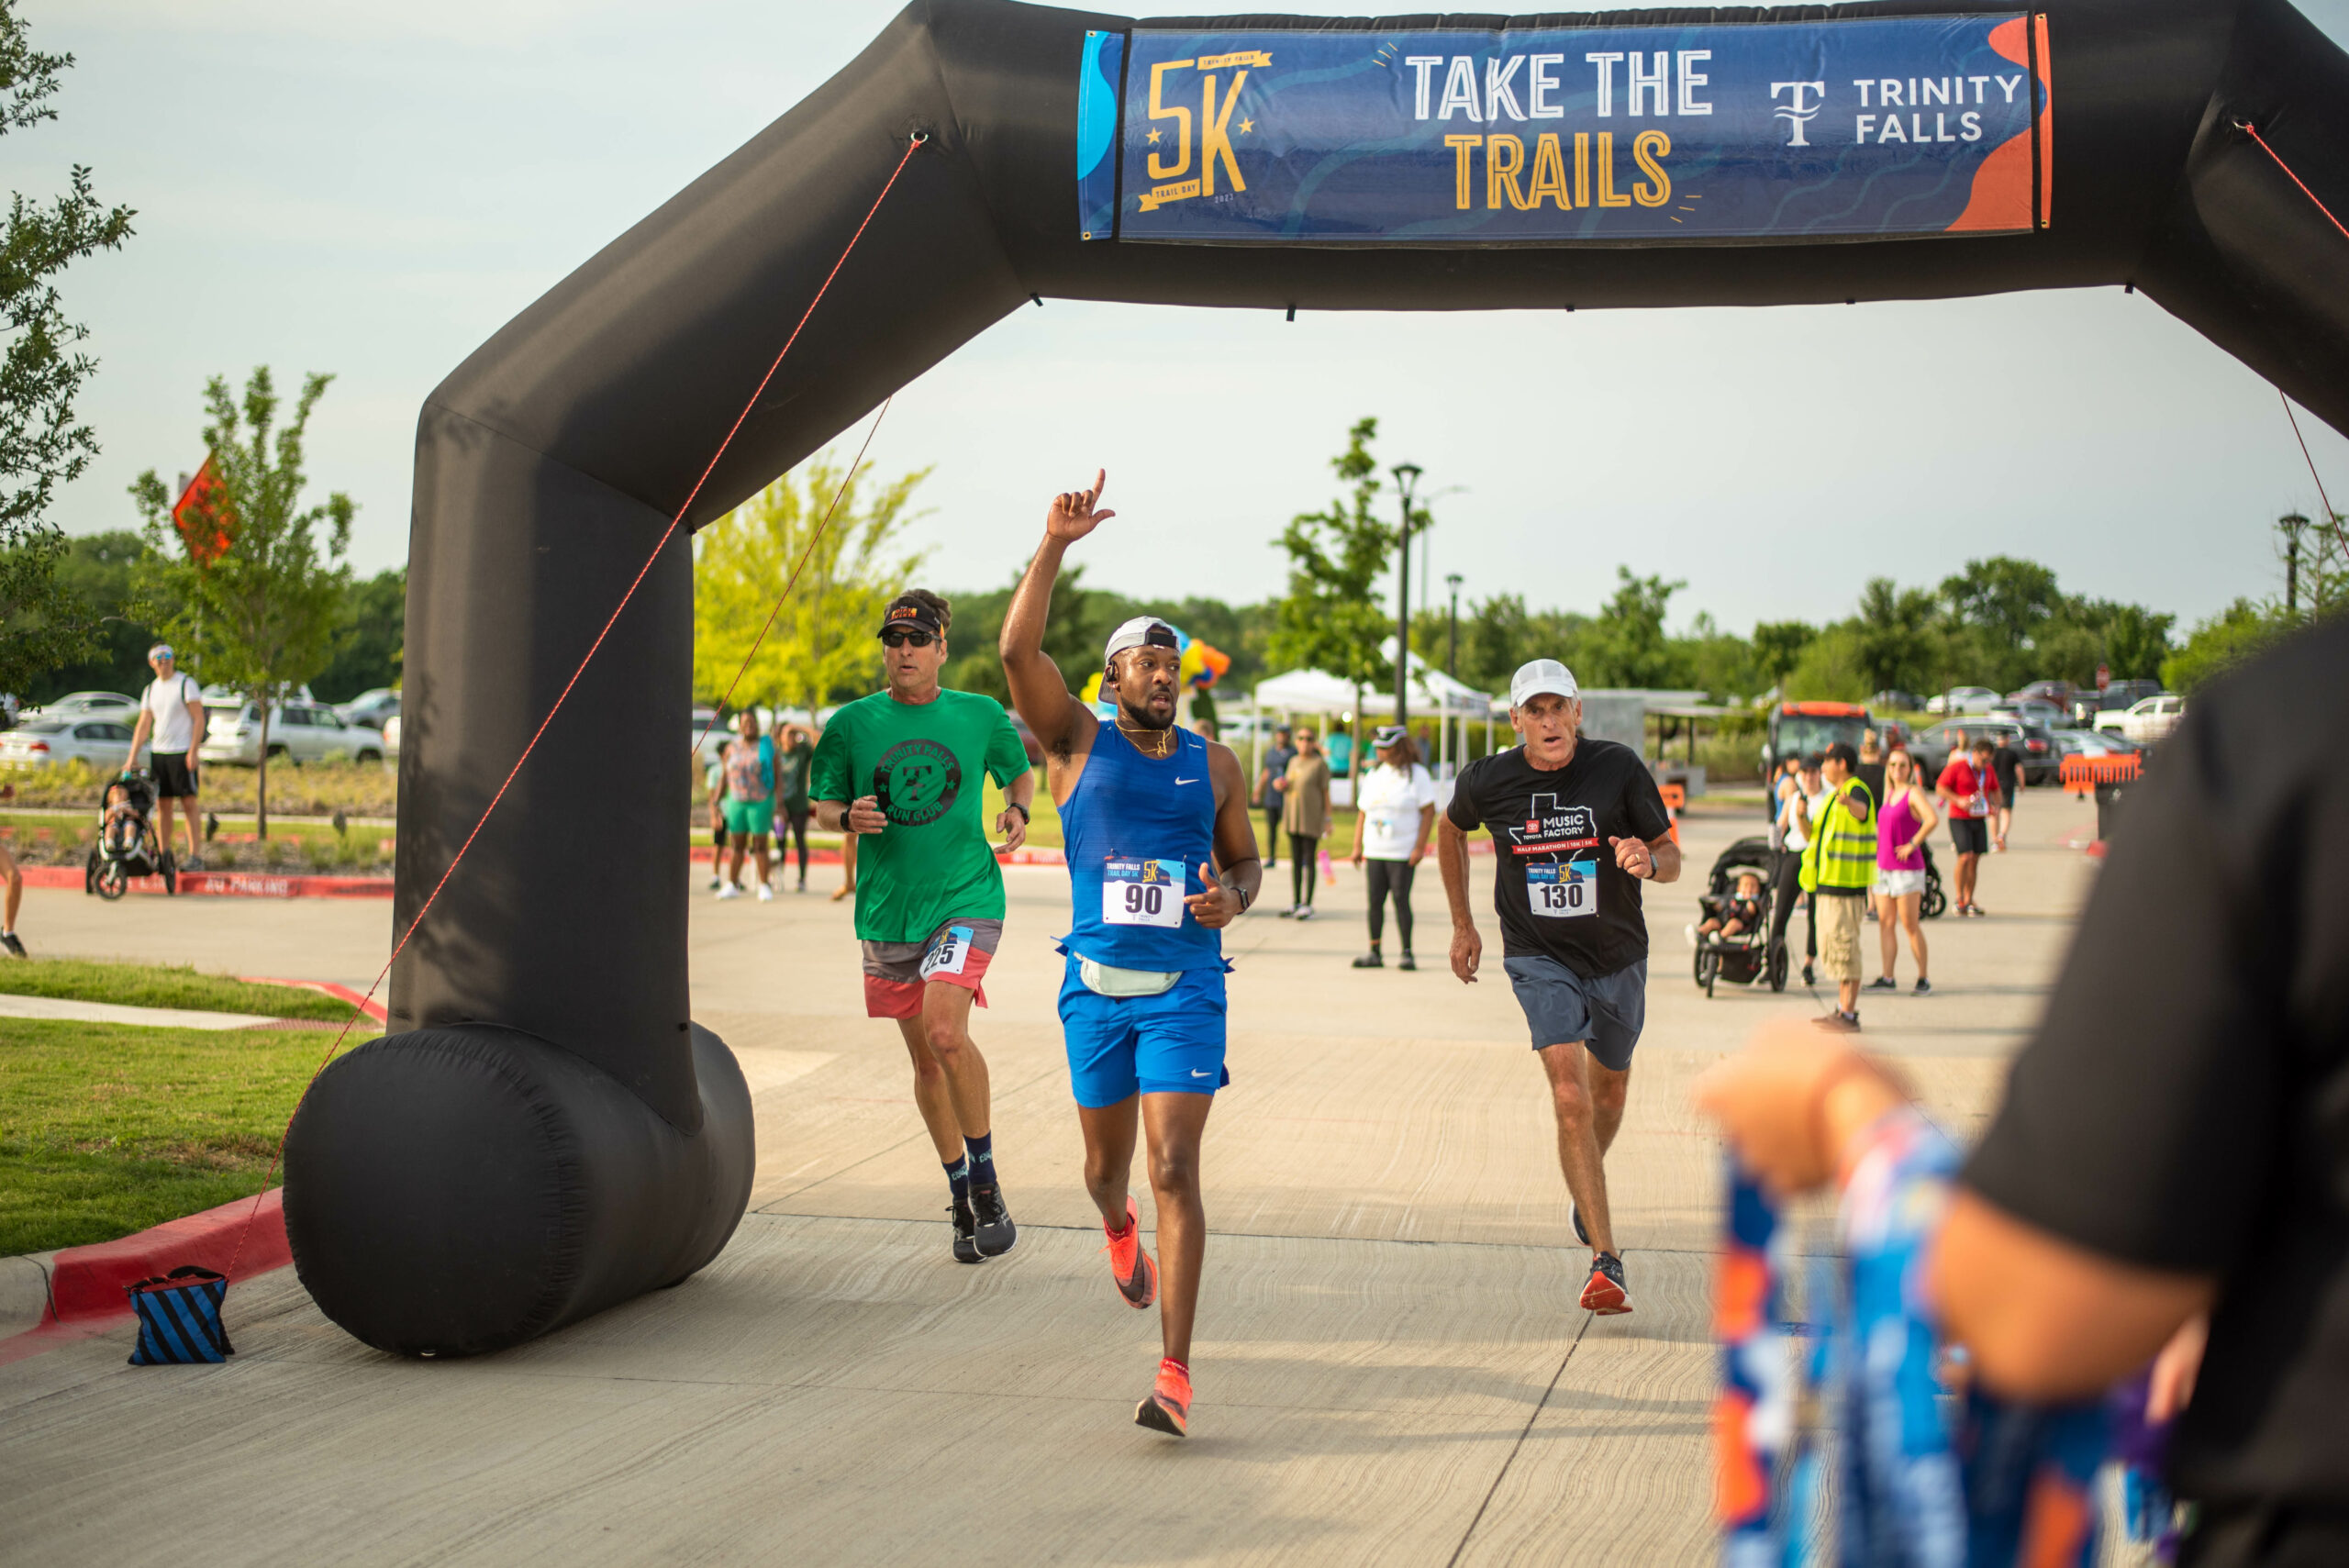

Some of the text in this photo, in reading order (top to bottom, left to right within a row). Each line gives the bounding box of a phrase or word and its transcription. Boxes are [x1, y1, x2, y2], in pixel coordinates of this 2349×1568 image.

[1405, 50, 1712, 122] TAKE THE
[1854, 74, 2022, 107] TRINITY
[1147, 59, 1248, 196] 5K
[1856, 111, 1983, 144] FALLS
[1444, 129, 1672, 210] TRAILS
[1156, 183, 1197, 199] TRAIL DAY
[1214, 193, 1234, 204] 2023
[880, 743, 955, 773] TRINITY FALLS
[885, 800, 943, 822] RUN CLUB
[1542, 814, 1584, 829] MUSIC
[1543, 826, 1585, 839] FACTORY
[1531, 842, 1566, 851] MARATHON
[1143, 861, 1158, 882] 5K
[1559, 864, 1572, 882] 5K
[231, 877, 288, 895] PARKING
[1540, 884, 1583, 909] 130
[1125, 884, 1163, 915] 90
[923, 944, 955, 974] 225
